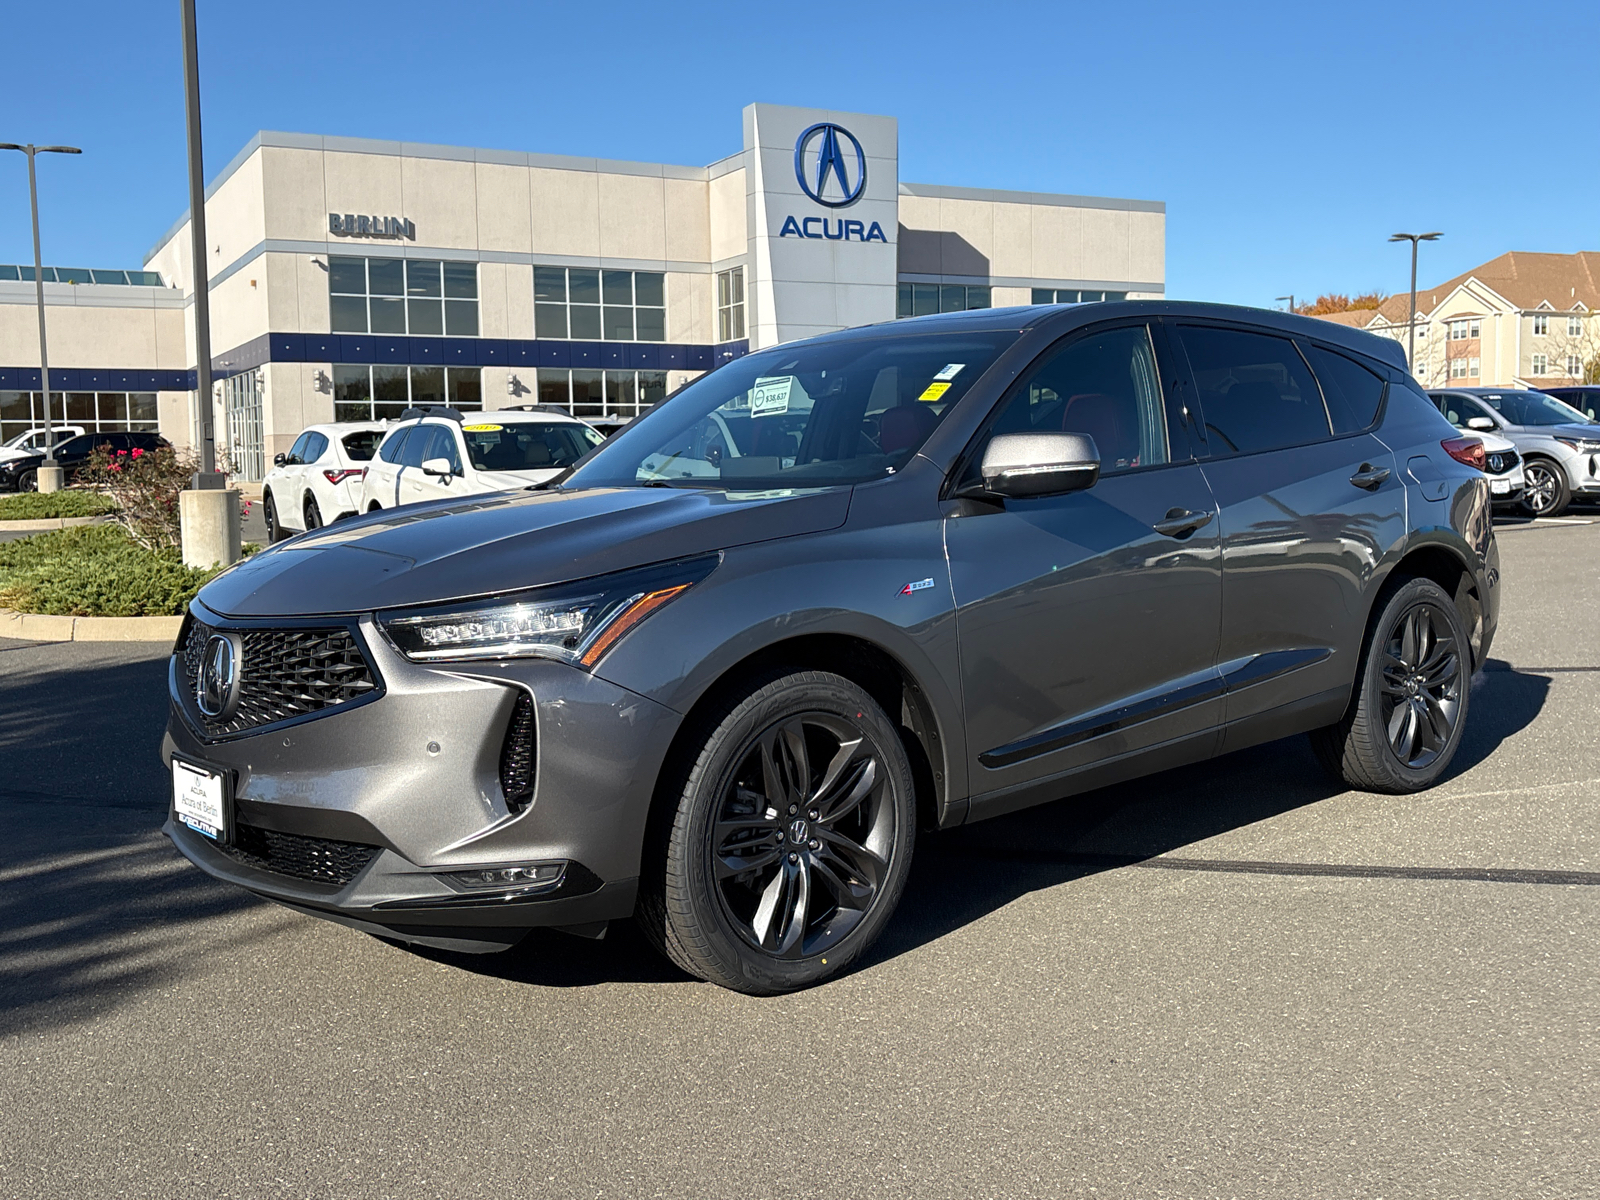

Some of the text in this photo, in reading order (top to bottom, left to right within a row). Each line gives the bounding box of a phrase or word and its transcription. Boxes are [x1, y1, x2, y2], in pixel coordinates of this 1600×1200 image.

[329, 213, 409, 236] BERLIN
[779, 215, 888, 243] ACURA
[179, 813, 217, 836] EXECUTIVE
